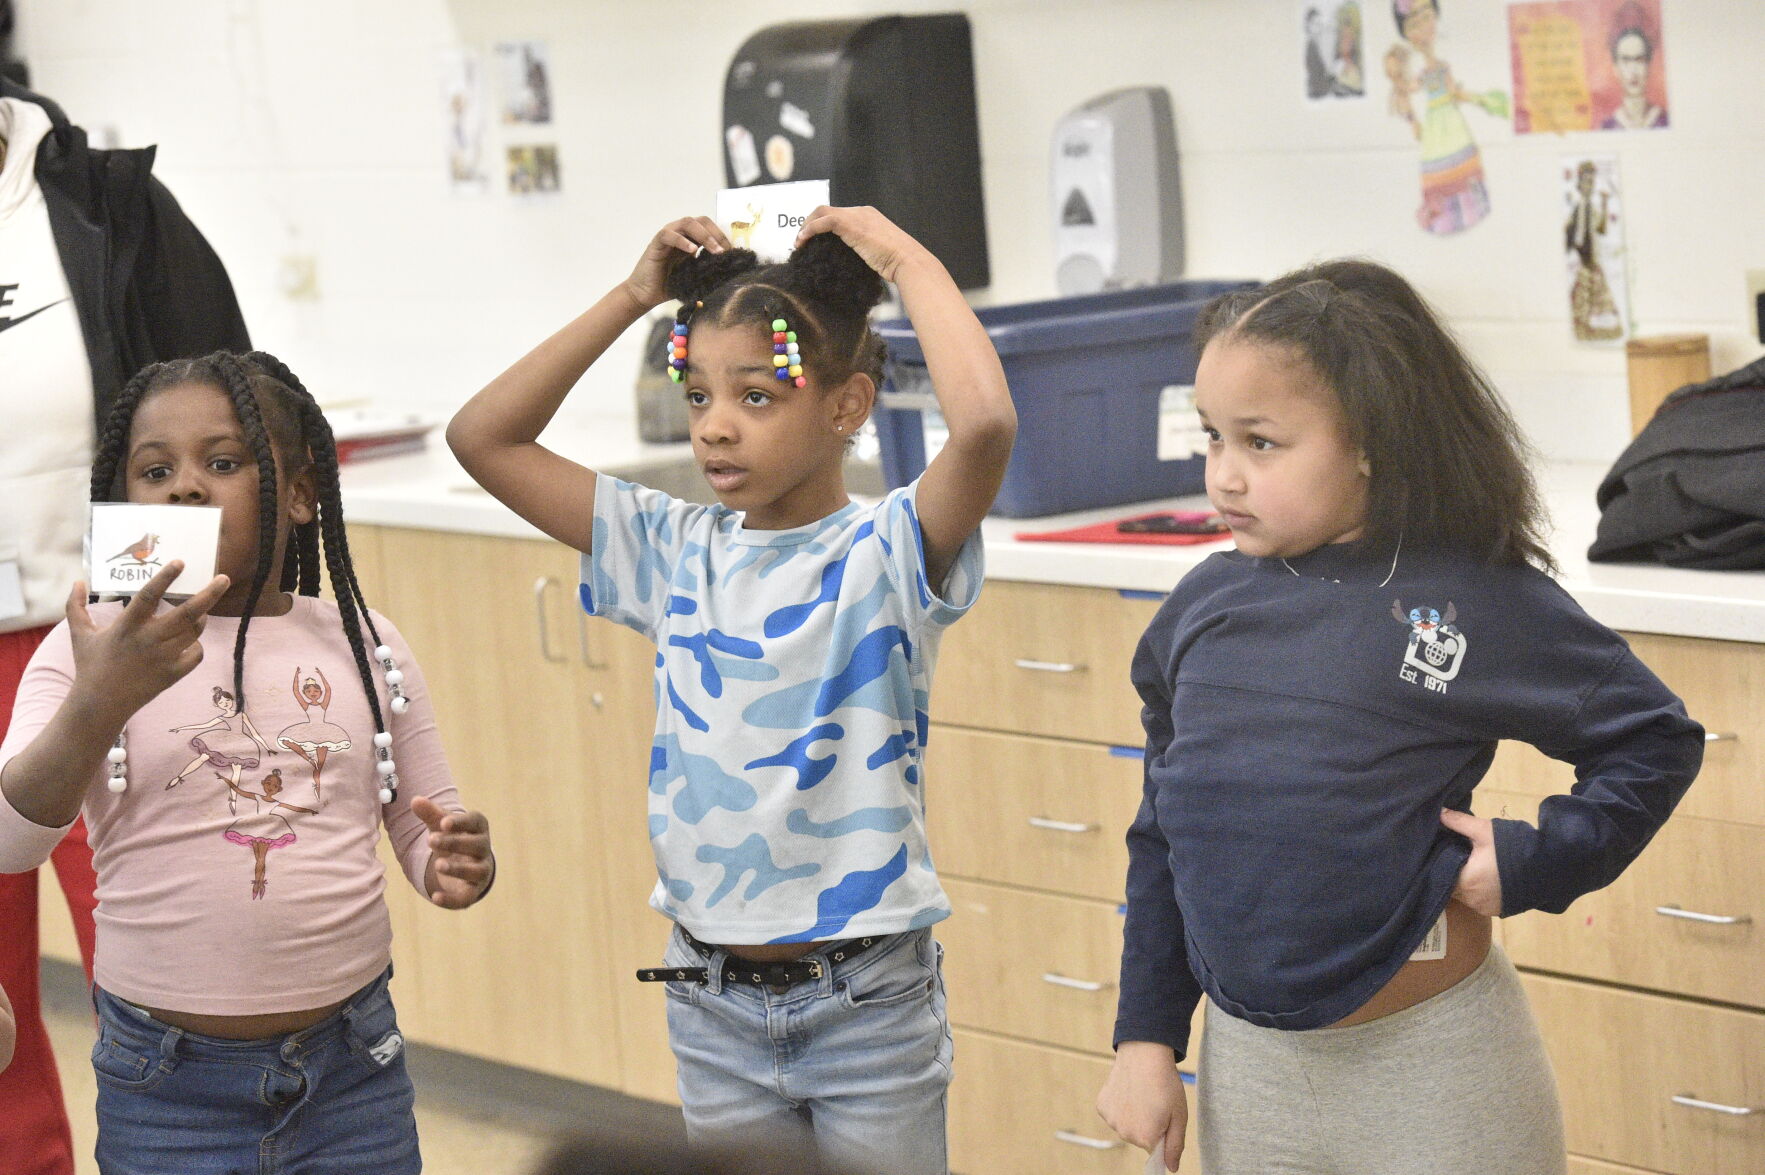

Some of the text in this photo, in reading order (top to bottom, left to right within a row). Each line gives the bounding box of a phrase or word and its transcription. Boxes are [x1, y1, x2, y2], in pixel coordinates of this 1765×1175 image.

[777, 213, 806, 229] Dee
[110, 567, 153, 581] ROBIN
[1424, 675, 1448, 694] 1971
